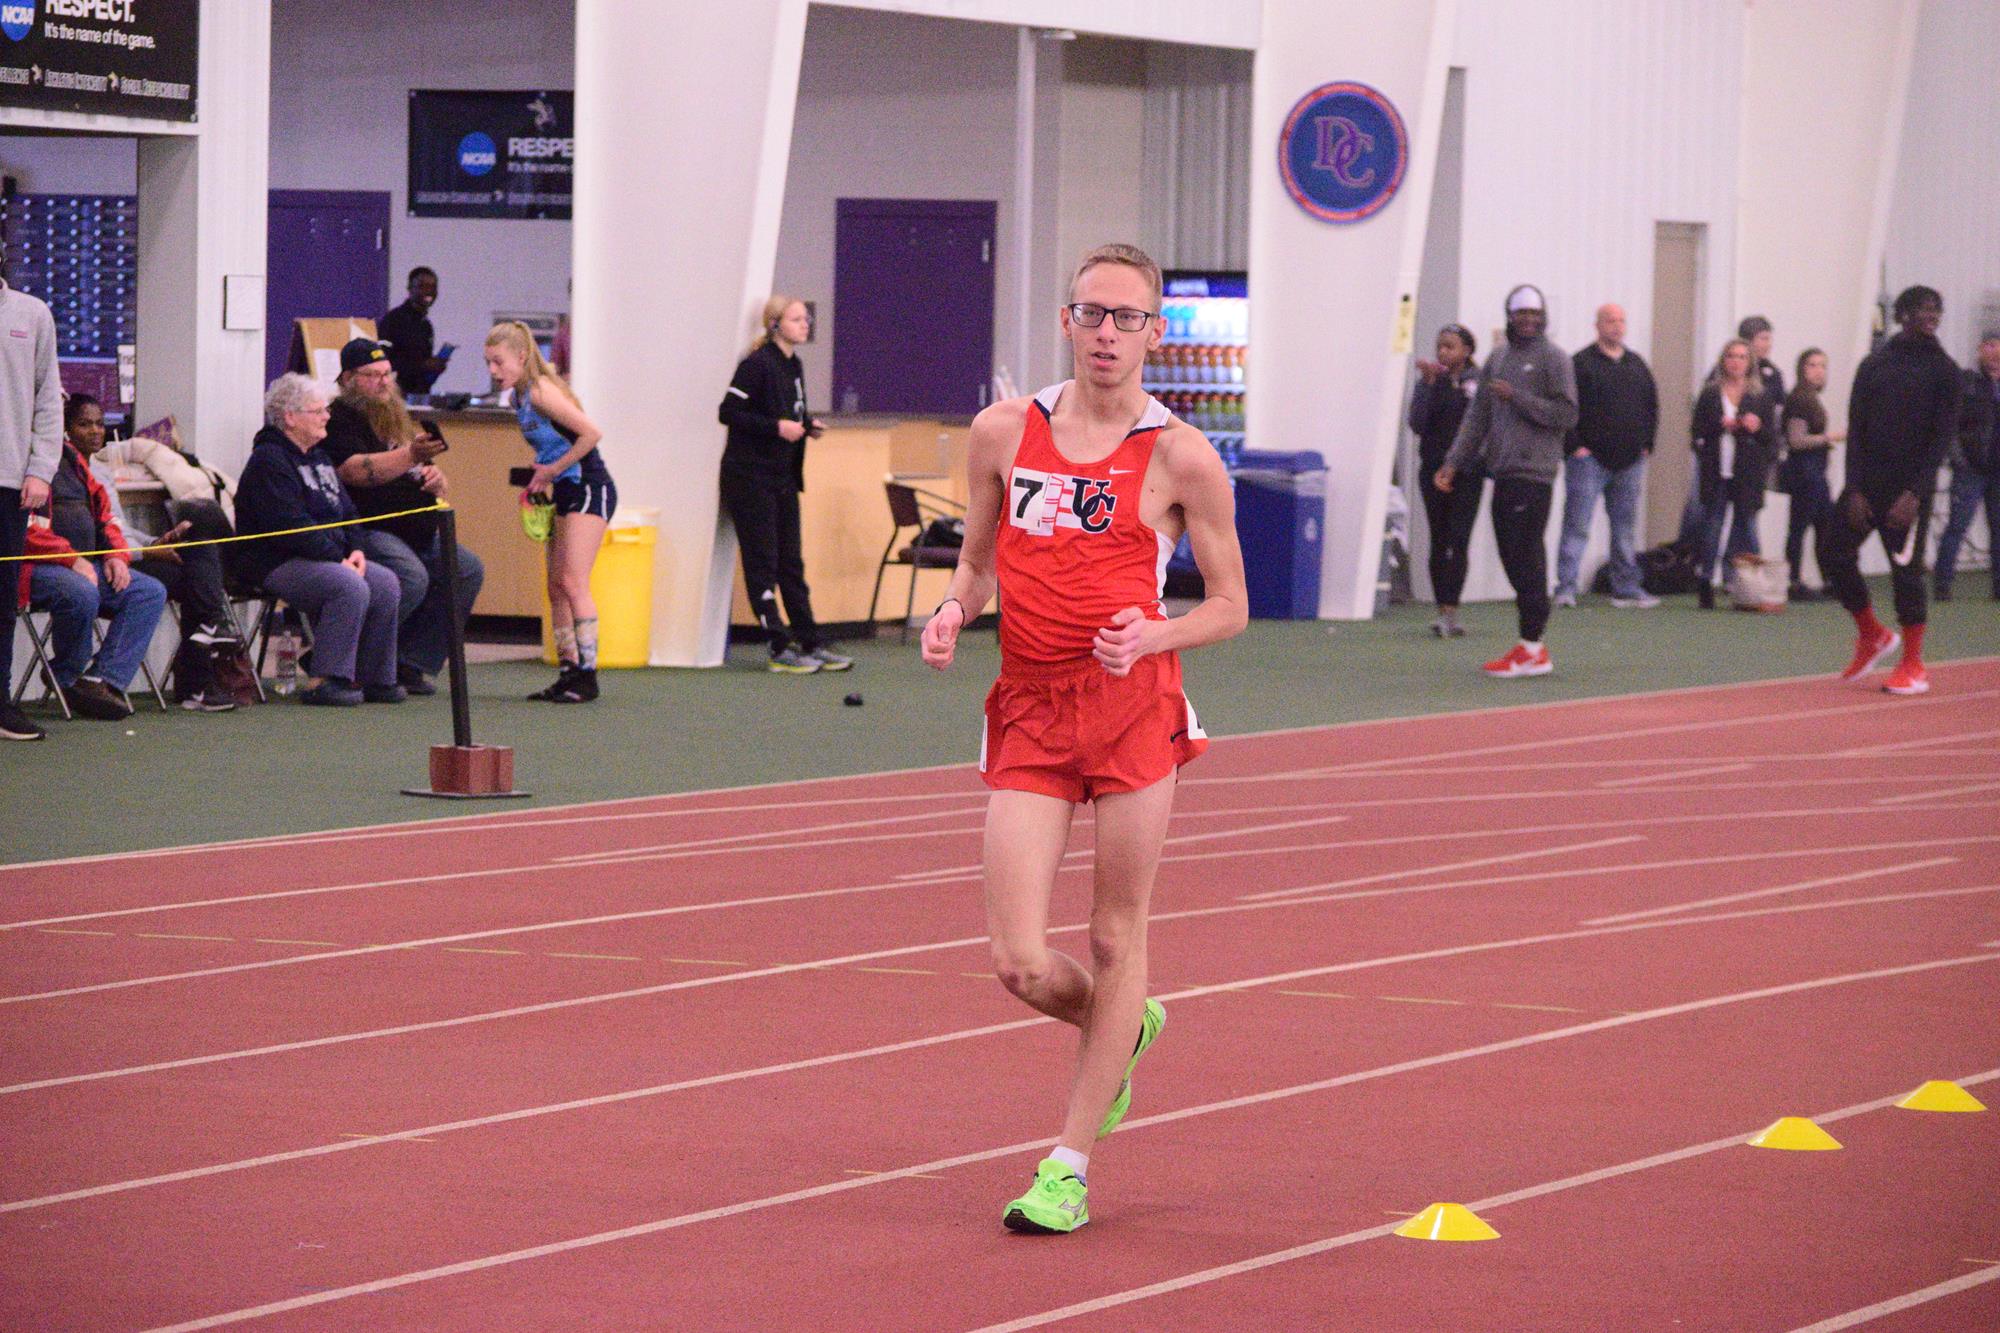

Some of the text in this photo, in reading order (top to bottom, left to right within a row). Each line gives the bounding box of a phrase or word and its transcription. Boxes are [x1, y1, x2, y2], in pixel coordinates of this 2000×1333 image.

[2, 5, 35, 25] NCAA
[46, 0, 135, 22] RESPECT.
[44, 22, 156, 50] It's the name of the game.
[1312, 116, 1375, 187] DC
[1014, 477, 1043, 519] 7
[1071, 477, 1117, 533] UC
